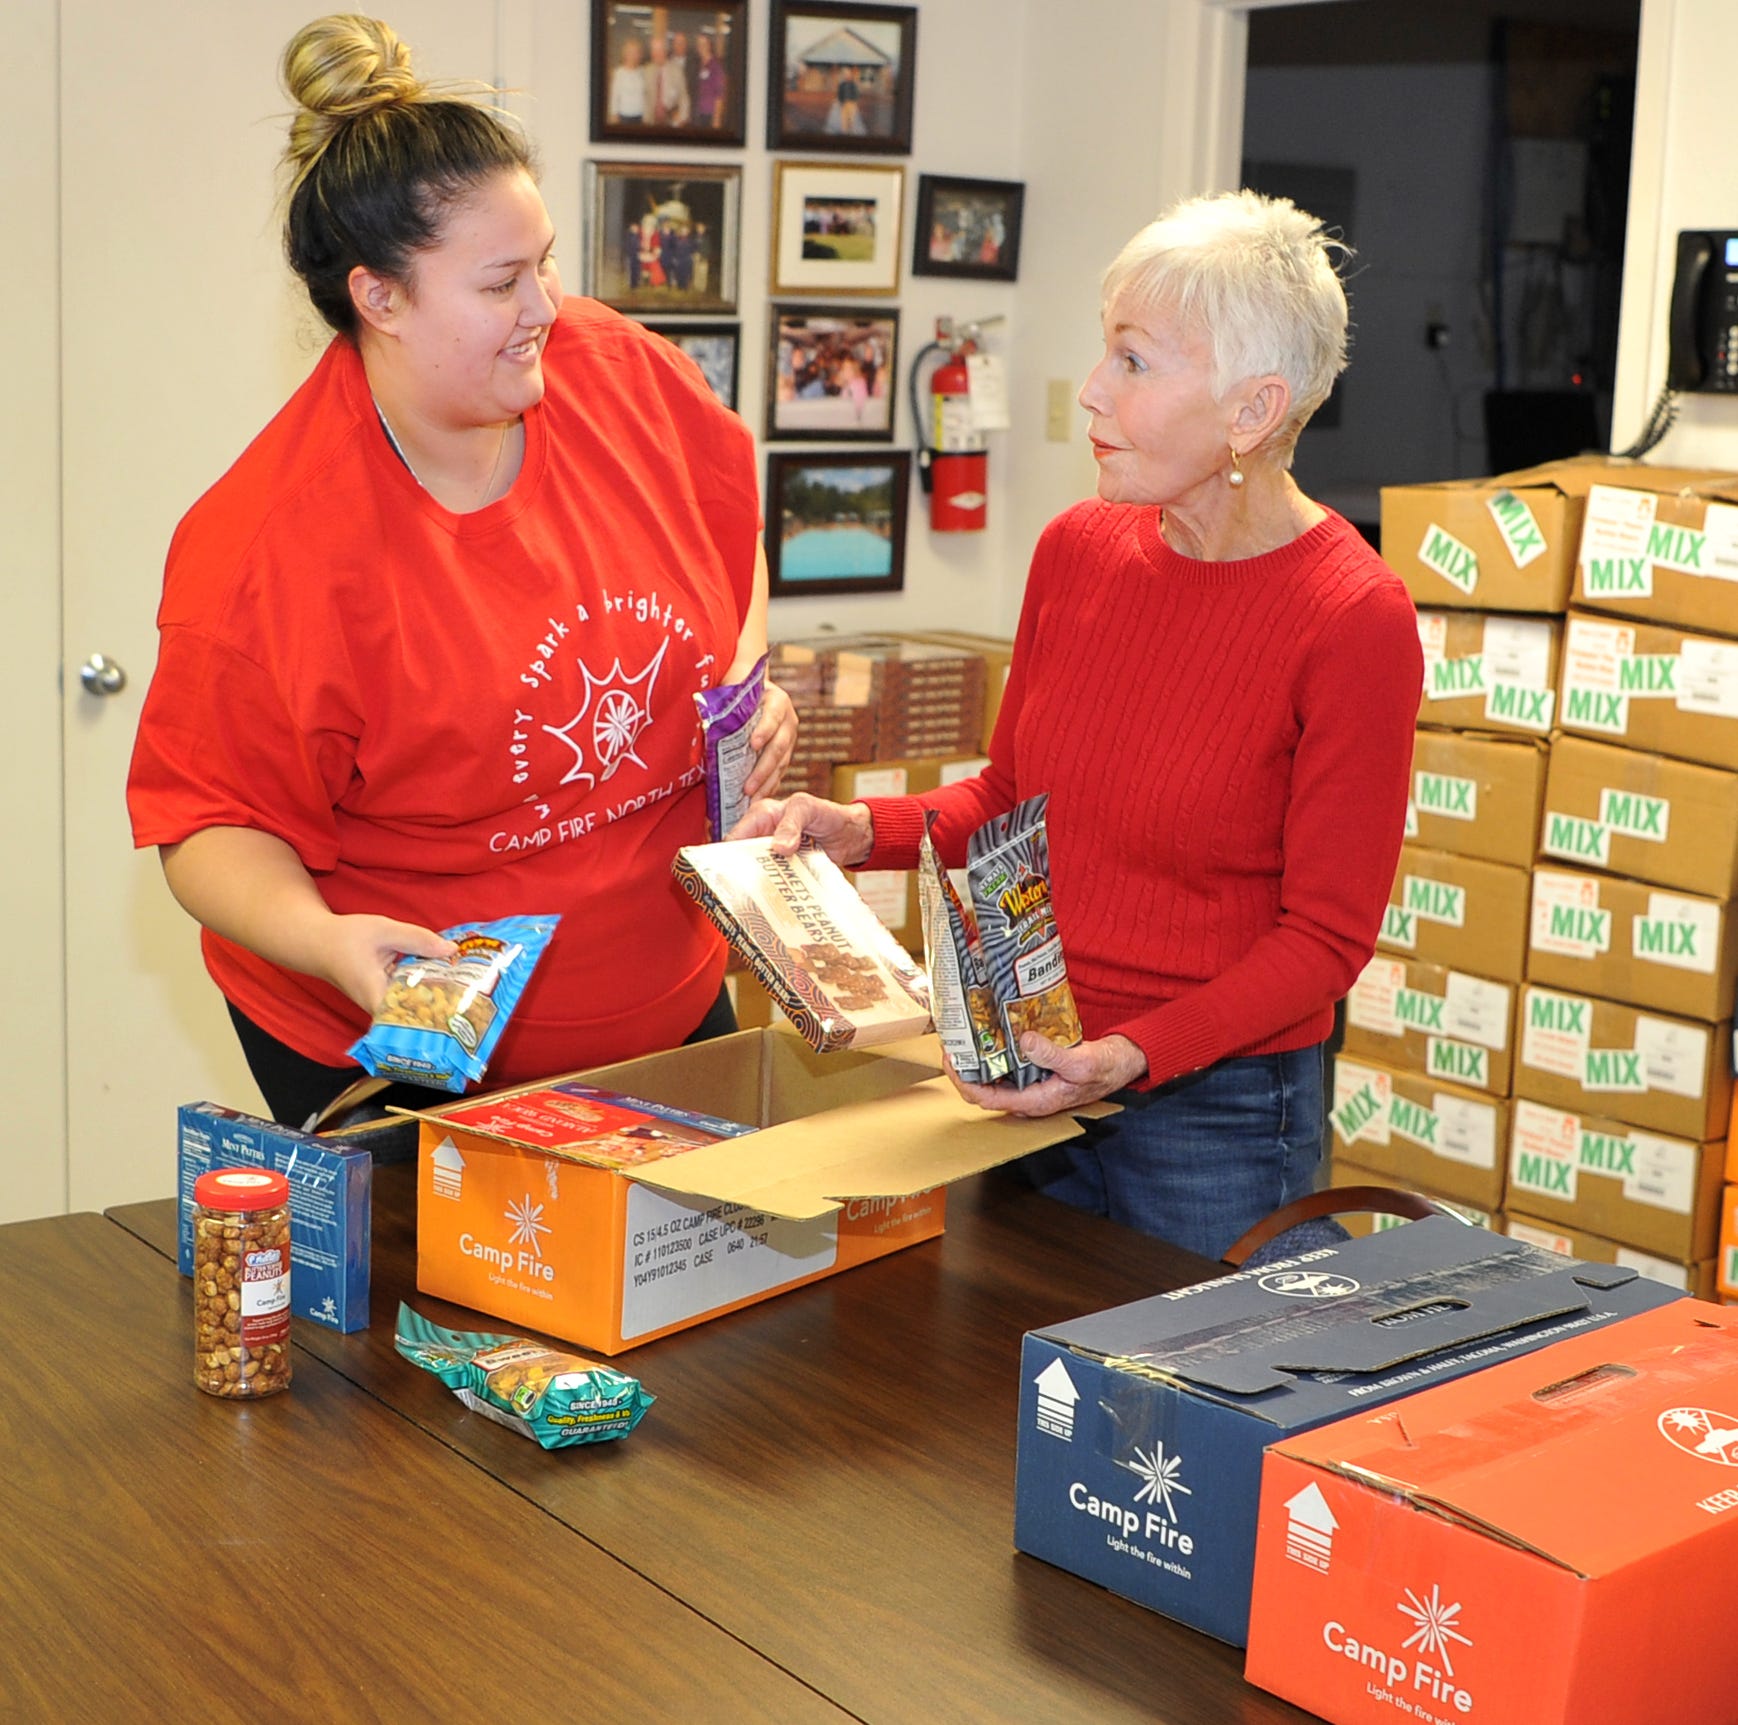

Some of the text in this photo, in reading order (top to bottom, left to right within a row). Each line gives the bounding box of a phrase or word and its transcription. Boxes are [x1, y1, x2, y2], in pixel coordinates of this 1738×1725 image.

[1494, 493, 1542, 557] MIX
[1425, 533, 1478, 585] MIX
[1647, 525, 1706, 568] MIX
[1590, 558, 1645, 590] MIX
[577, 604, 589, 621] a
[603, 589, 693, 641] brighter
[1434, 657, 1484, 691] MIX
[1620, 657, 1676, 691] MIX
[1492, 684, 1547, 722] MIX
[1568, 688, 1622, 726] MIX
[1420, 776, 1472, 813] MIX
[1605, 793, 1663, 834] MIX
[1550, 817, 1605, 857] MIX
[756, 856, 829, 943] BUTTER BEARS
[1408, 880, 1460, 919] MIX
[807, 898, 852, 949] PEANUT
[1383, 908, 1413, 941] IX
[1550, 904, 1606, 943] MIX
[1639, 919, 1697, 956] MIX
[1395, 989, 1445, 1030] MIX
[1531, 996, 1585, 1034] MIX
[1434, 1040, 1482, 1081] MIX
[1586, 1053, 1641, 1086] MIX
[1337, 1083, 1381, 1138] MIX
[1389, 1094, 1439, 1144] MIX
[1518, 1153, 1571, 1195] MIX
[1580, 1133, 1636, 1176] MIX
[633, 1232, 645, 1247] CS
[670, 1218, 682, 1234] OZ
[682, 1212, 706, 1232] CAMP
[698, 1228, 718, 1246] CASE
[459, 1233, 555, 1282] Camp Fire
[694, 1249, 714, 1268] CASE
[1252, 1259, 1302, 1276] FROM
[1300, 1248, 1339, 1263] KEEP
[1069, 1483, 1194, 1556] Camp Fire
[1106, 1534, 1192, 1579] Light the fire within
[1323, 1621, 1473, 1713] Camp Fire
[1366, 1681, 1393, 1704] Light
[1395, 1696, 1413, 1713] the
[1414, 1704, 1433, 1722] fire
